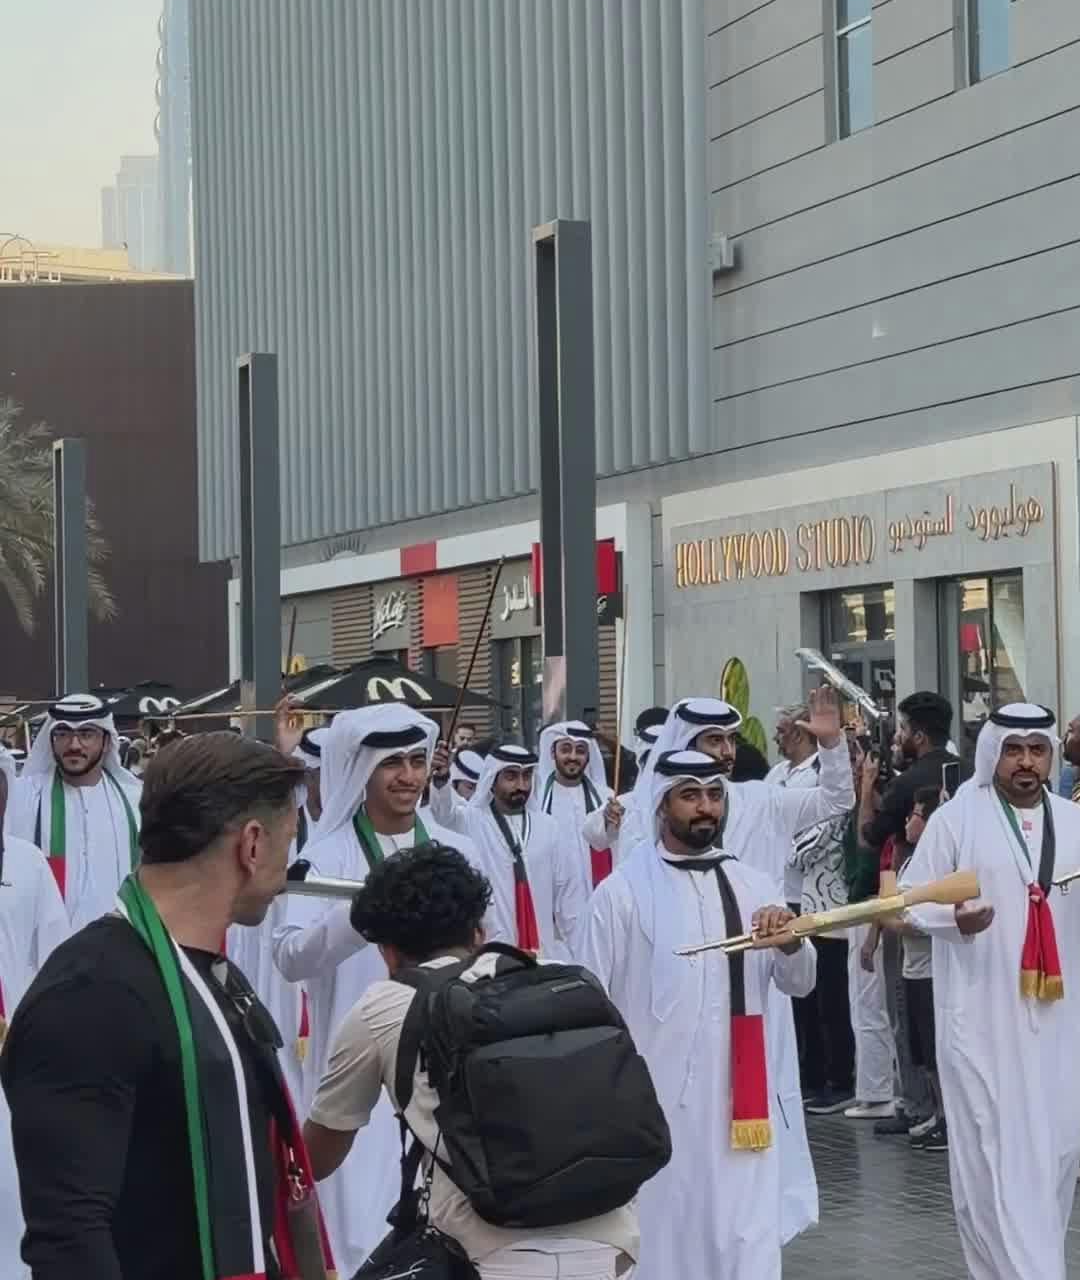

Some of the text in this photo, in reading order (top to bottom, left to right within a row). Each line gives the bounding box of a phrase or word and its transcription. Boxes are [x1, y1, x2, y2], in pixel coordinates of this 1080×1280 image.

[967, 480, 1044, 542] هوليوود
[676, 513, 876, 588] HOLLYWOOD STUDIO
